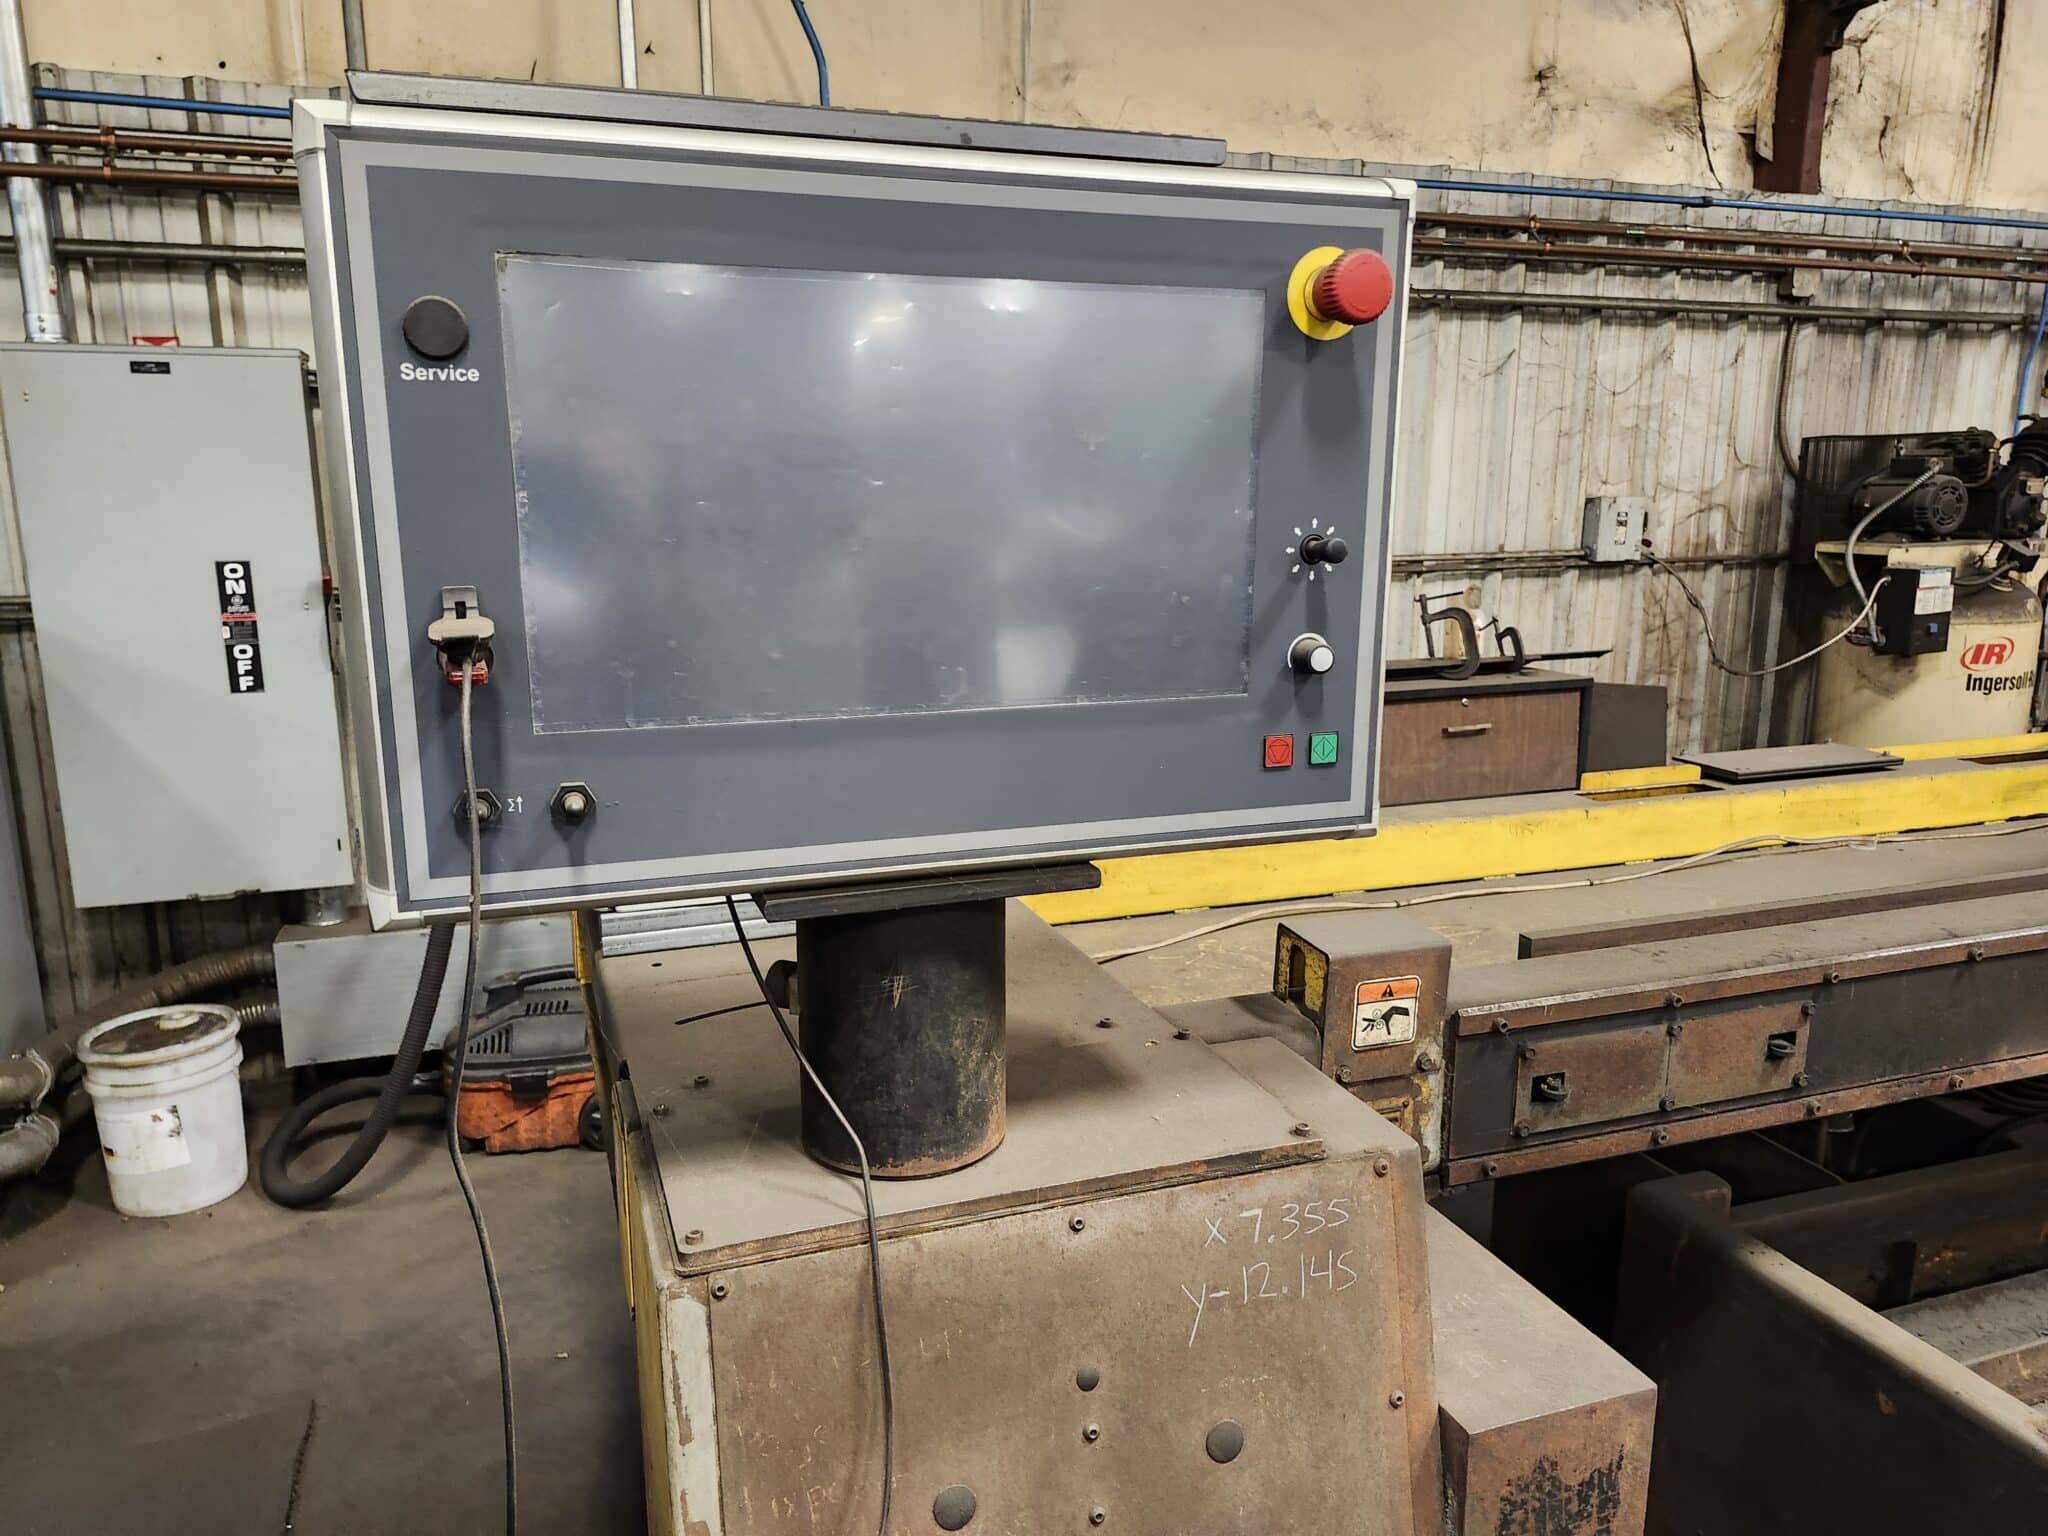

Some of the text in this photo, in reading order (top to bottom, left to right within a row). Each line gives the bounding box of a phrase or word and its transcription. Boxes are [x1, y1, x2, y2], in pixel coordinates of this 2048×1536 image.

[400, 362, 480, 382] Service
[223, 563, 247, 595] ON
[232, 644, 255, 692] OFF
[1969, 643, 2007, 665] IR
[1238, 1198, 1350, 1244] 7.355
